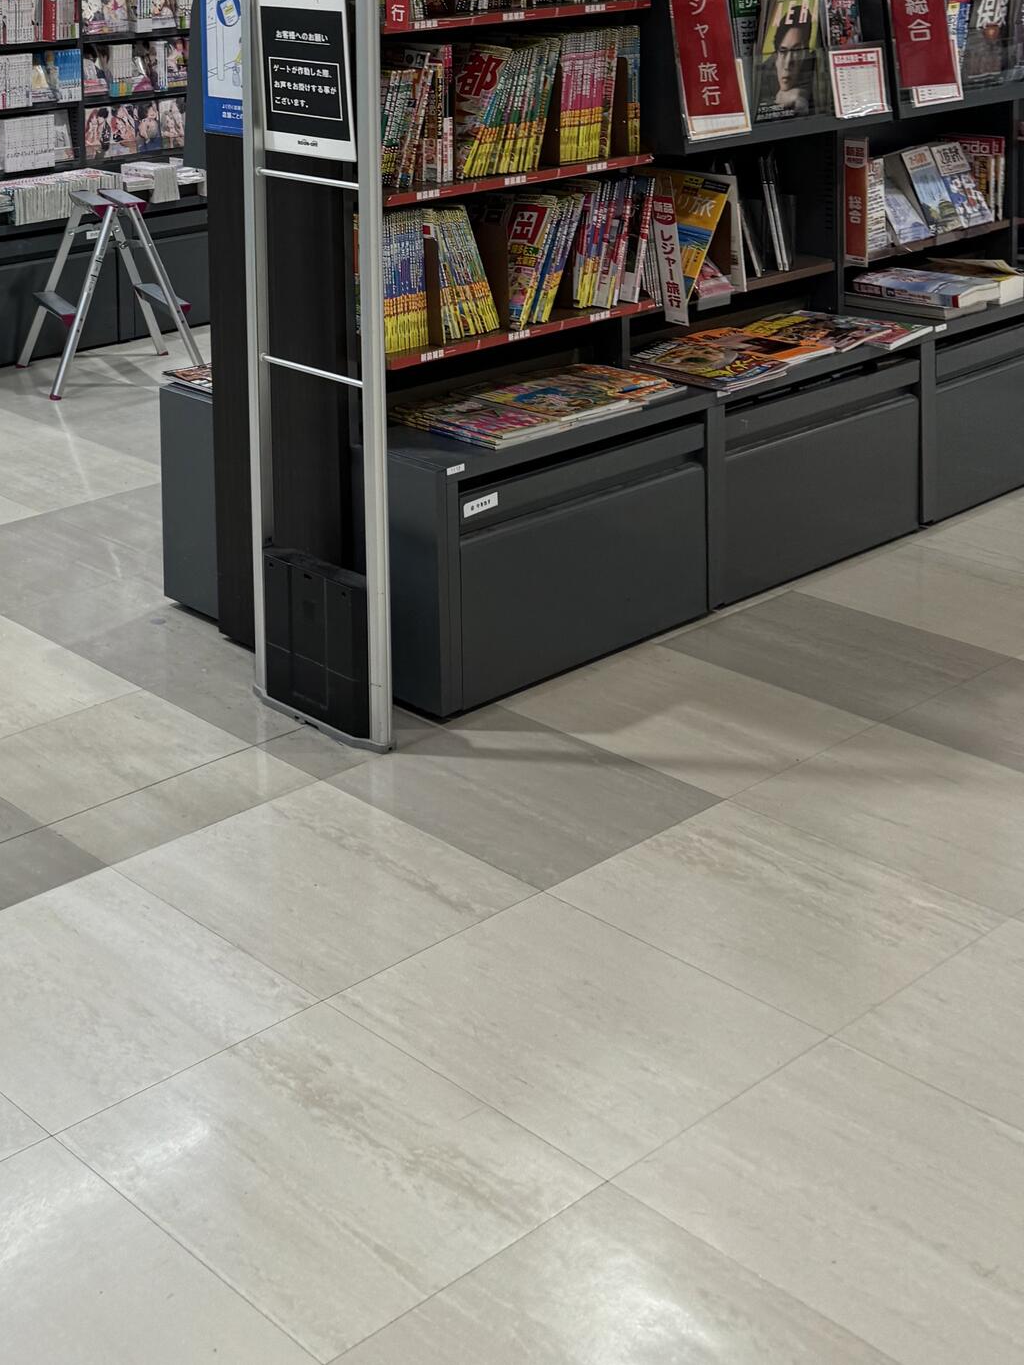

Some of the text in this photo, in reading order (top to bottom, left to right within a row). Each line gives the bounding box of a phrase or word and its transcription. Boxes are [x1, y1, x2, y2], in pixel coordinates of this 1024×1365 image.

[275, 30, 328, 43] お客様へのお願い
[274, 97, 310, 108] ございます。
[653, 200, 674, 213] 新品
[660, 229, 682, 309] レジャー旅行
